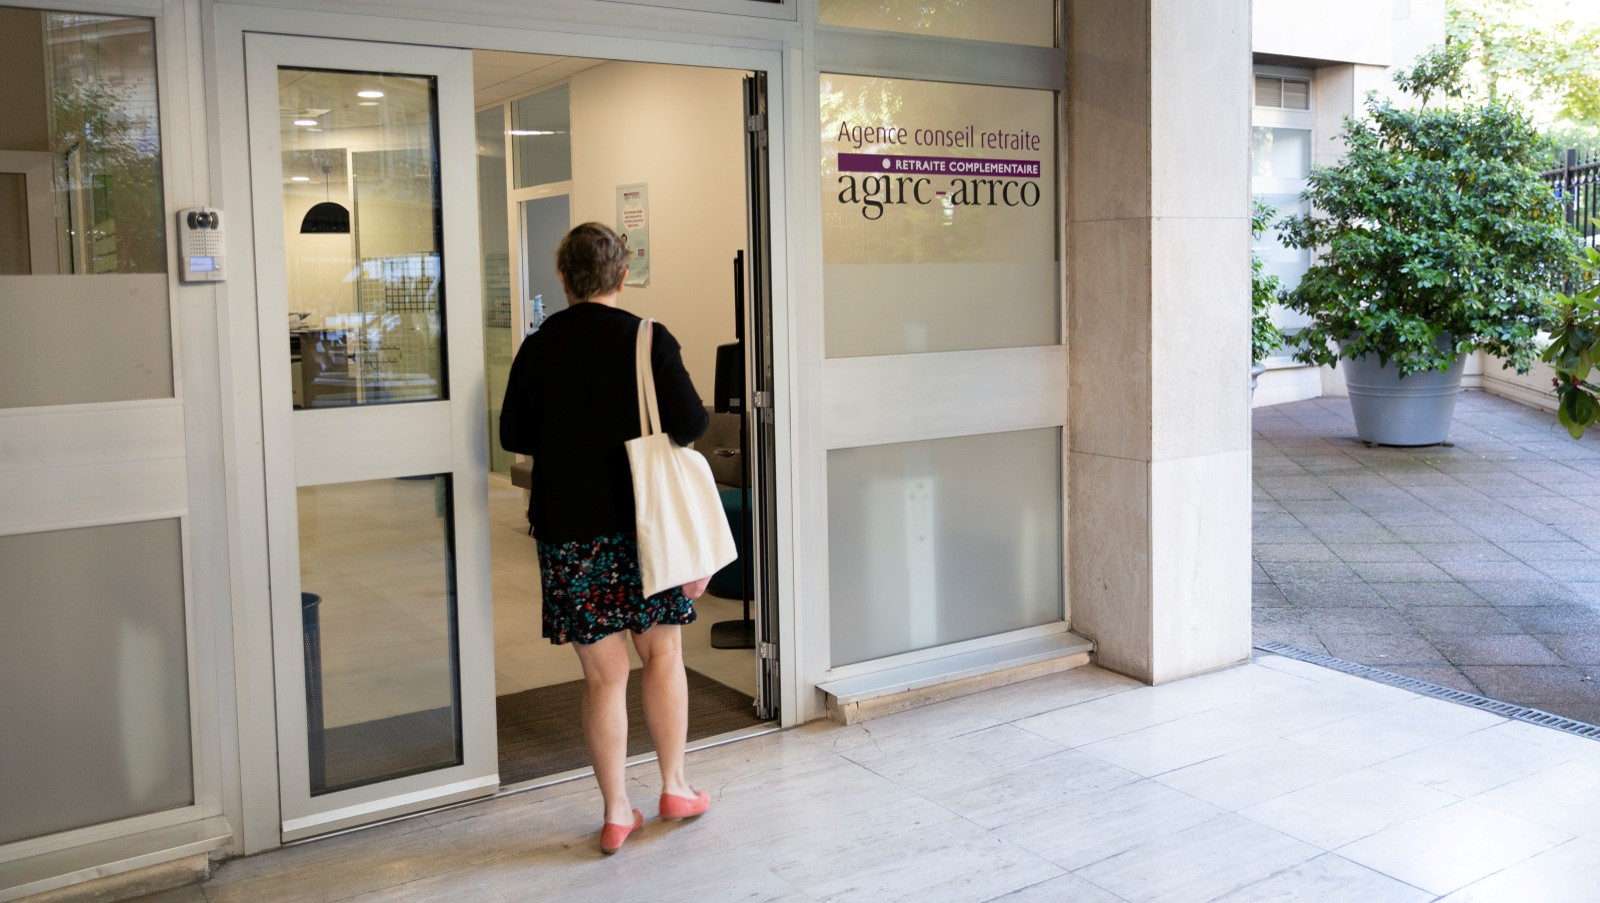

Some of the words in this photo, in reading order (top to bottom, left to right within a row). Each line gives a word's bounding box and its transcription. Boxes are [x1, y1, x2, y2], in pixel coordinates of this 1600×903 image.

[838, 121, 908, 149] Agence
[914, 125, 974, 148] conseil
[981, 129, 1041, 151] retraite
[895, 159, 946, 172] RETRAITE
[949, 161, 1039, 174] COMPLEMENTAIRE
[838, 173, 1041, 221] agirc-arrco
